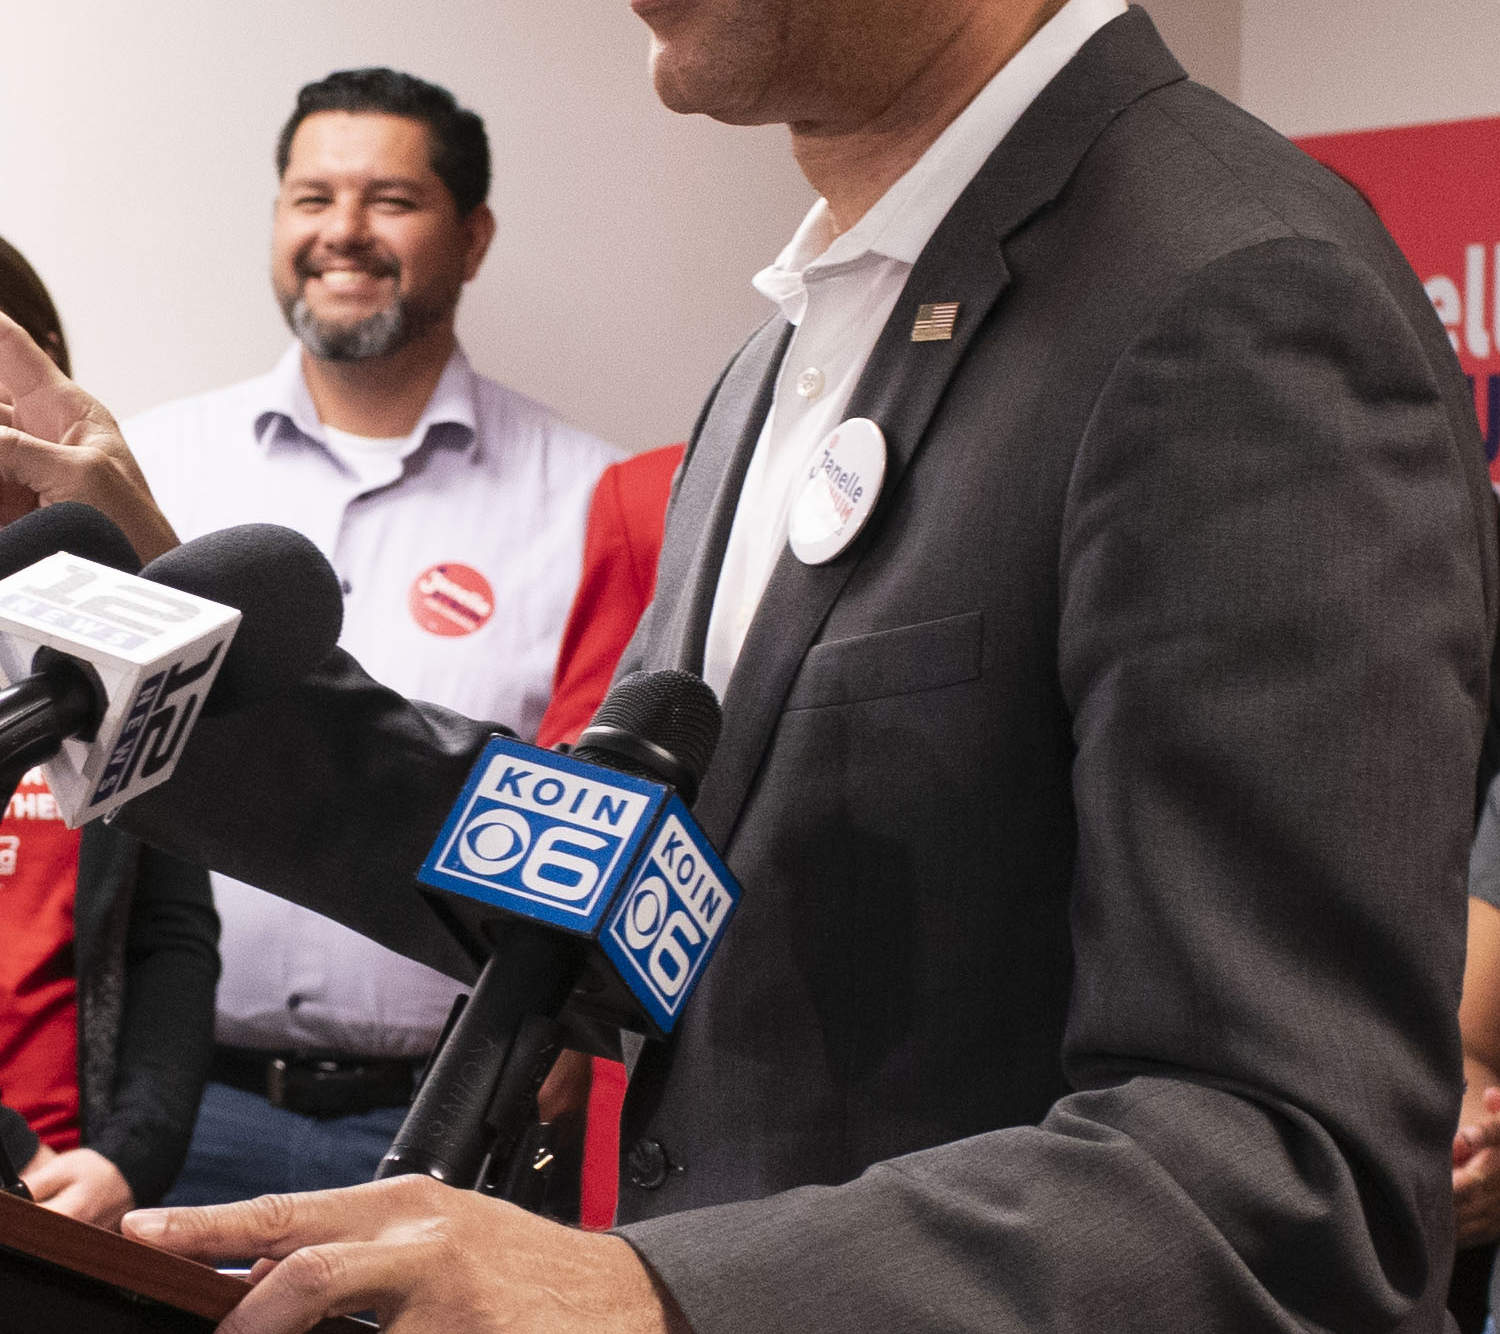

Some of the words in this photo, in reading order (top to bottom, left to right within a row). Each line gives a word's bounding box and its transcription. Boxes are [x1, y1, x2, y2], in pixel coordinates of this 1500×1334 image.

[5, 593, 135, 649] NEWS
[19, 564, 203, 636] 12
[100, 682, 160, 791] NEWS
[117, 640, 226, 793] 12
[493, 766, 629, 828] KOIN
[520, 825, 608, 902] 6
[661, 829, 721, 925] KOIN
[648, 914, 702, 998] 6
